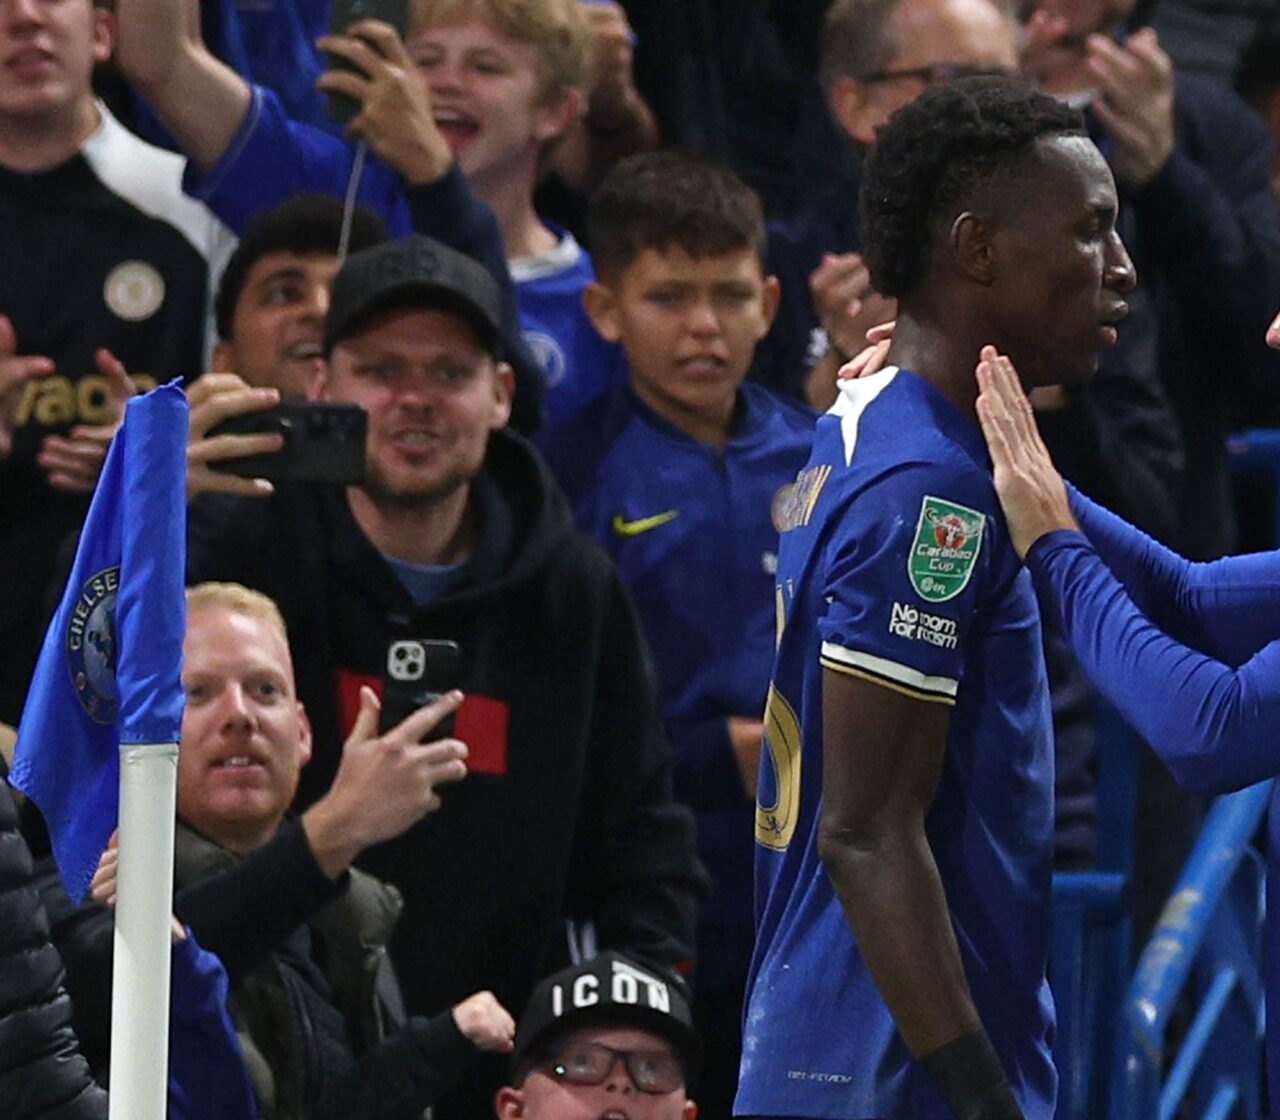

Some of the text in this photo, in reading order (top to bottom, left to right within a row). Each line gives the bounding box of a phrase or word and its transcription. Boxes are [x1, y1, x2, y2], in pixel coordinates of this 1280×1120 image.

[929, 558, 955, 572] Cup
[890, 601, 919, 624] No
[552, 973, 671, 1018] ICON
